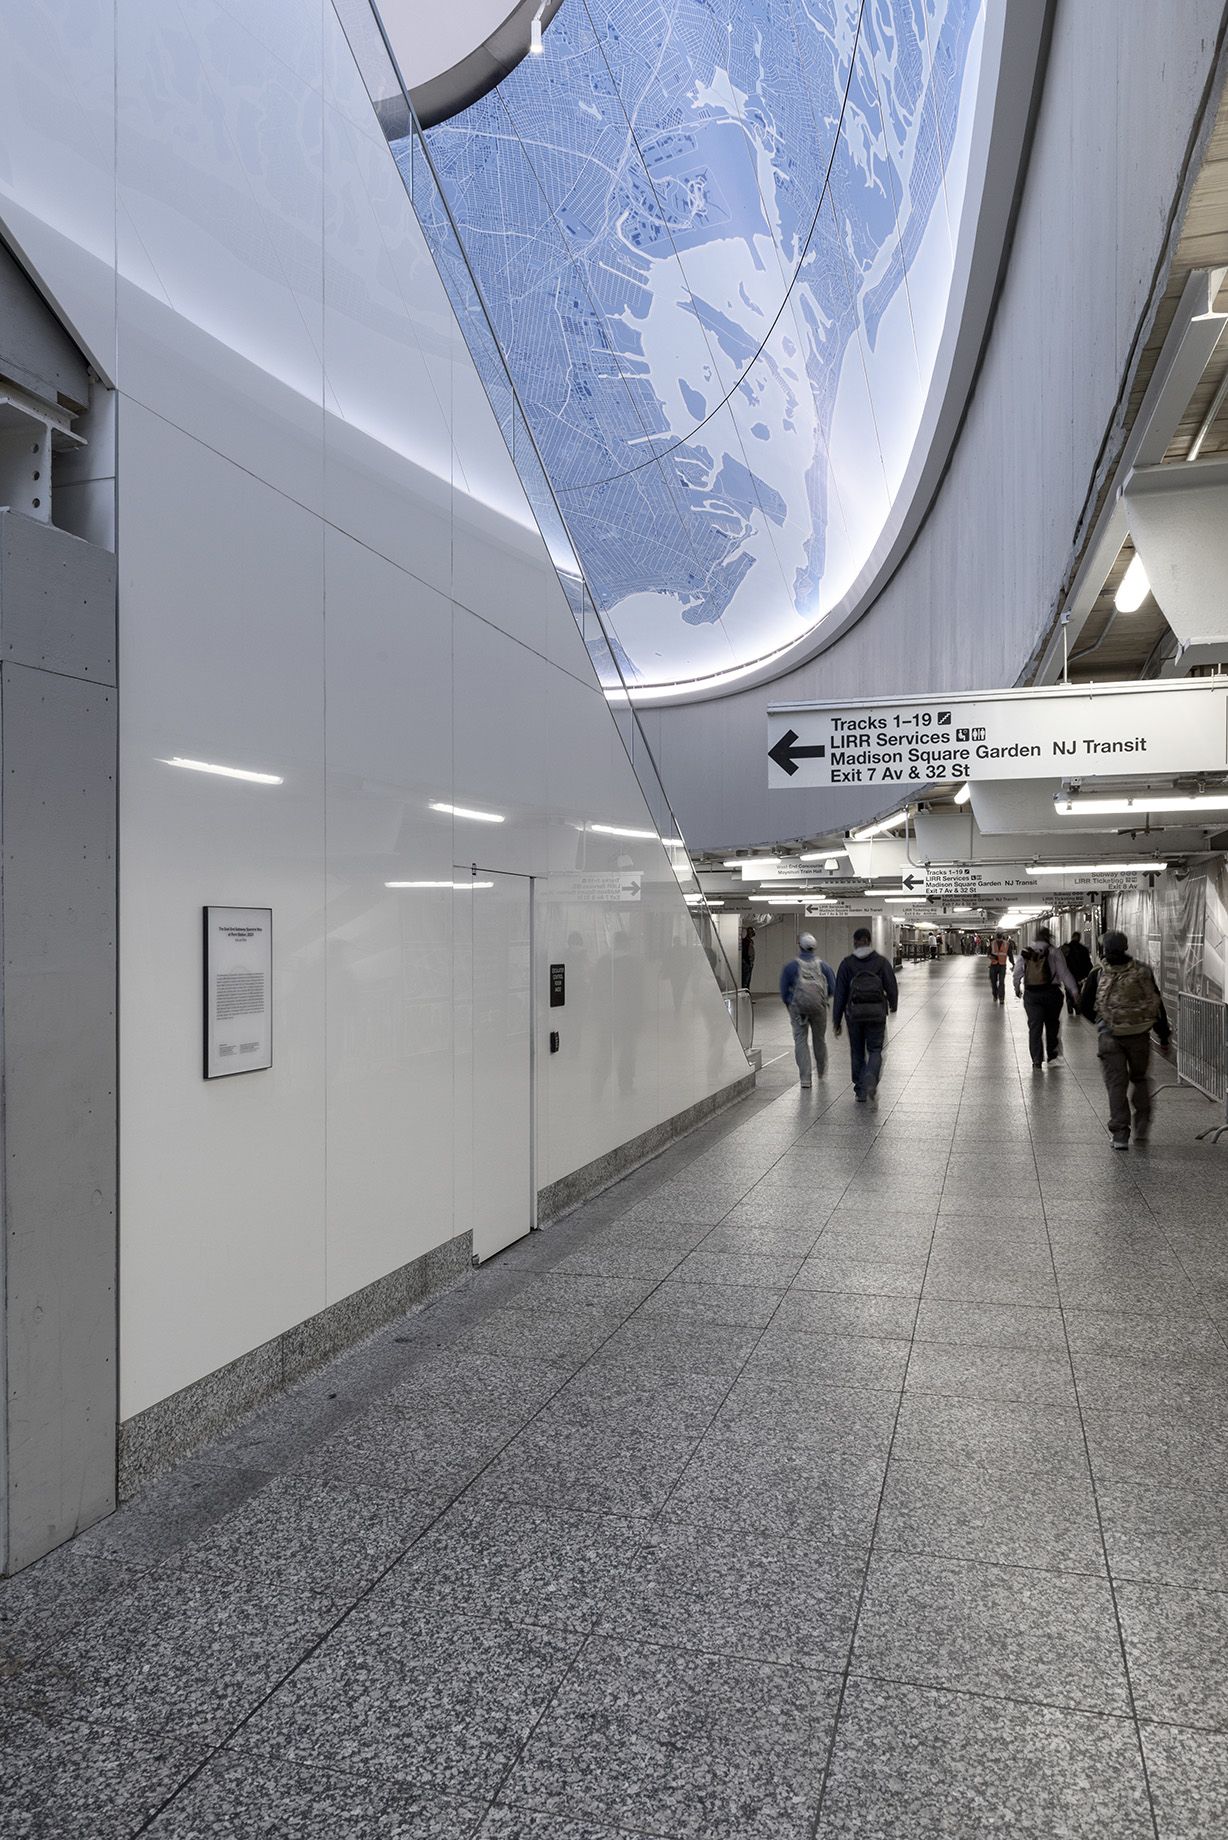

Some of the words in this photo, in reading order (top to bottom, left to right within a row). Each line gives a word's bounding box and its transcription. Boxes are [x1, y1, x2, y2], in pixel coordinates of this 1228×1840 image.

[831, 716, 887, 731] Tracks
[831, 735, 870, 749] LIRR
[877, 731, 950, 747] Services
[831, 751, 903, 766] Madison
[908, 748, 970, 764] Square
[976, 744, 1041, 759] Garden
[1053, 741, 1076, 755] NJ
[1083, 737, 1147, 754] Transit
[831, 768, 862, 783] Exit
[867, 768, 877, 781] 7
[882, 767, 903, 780] Av
[908, 765, 921, 779] &
[925, 765, 946, 779] 32
[951, 763, 970, 777] St
